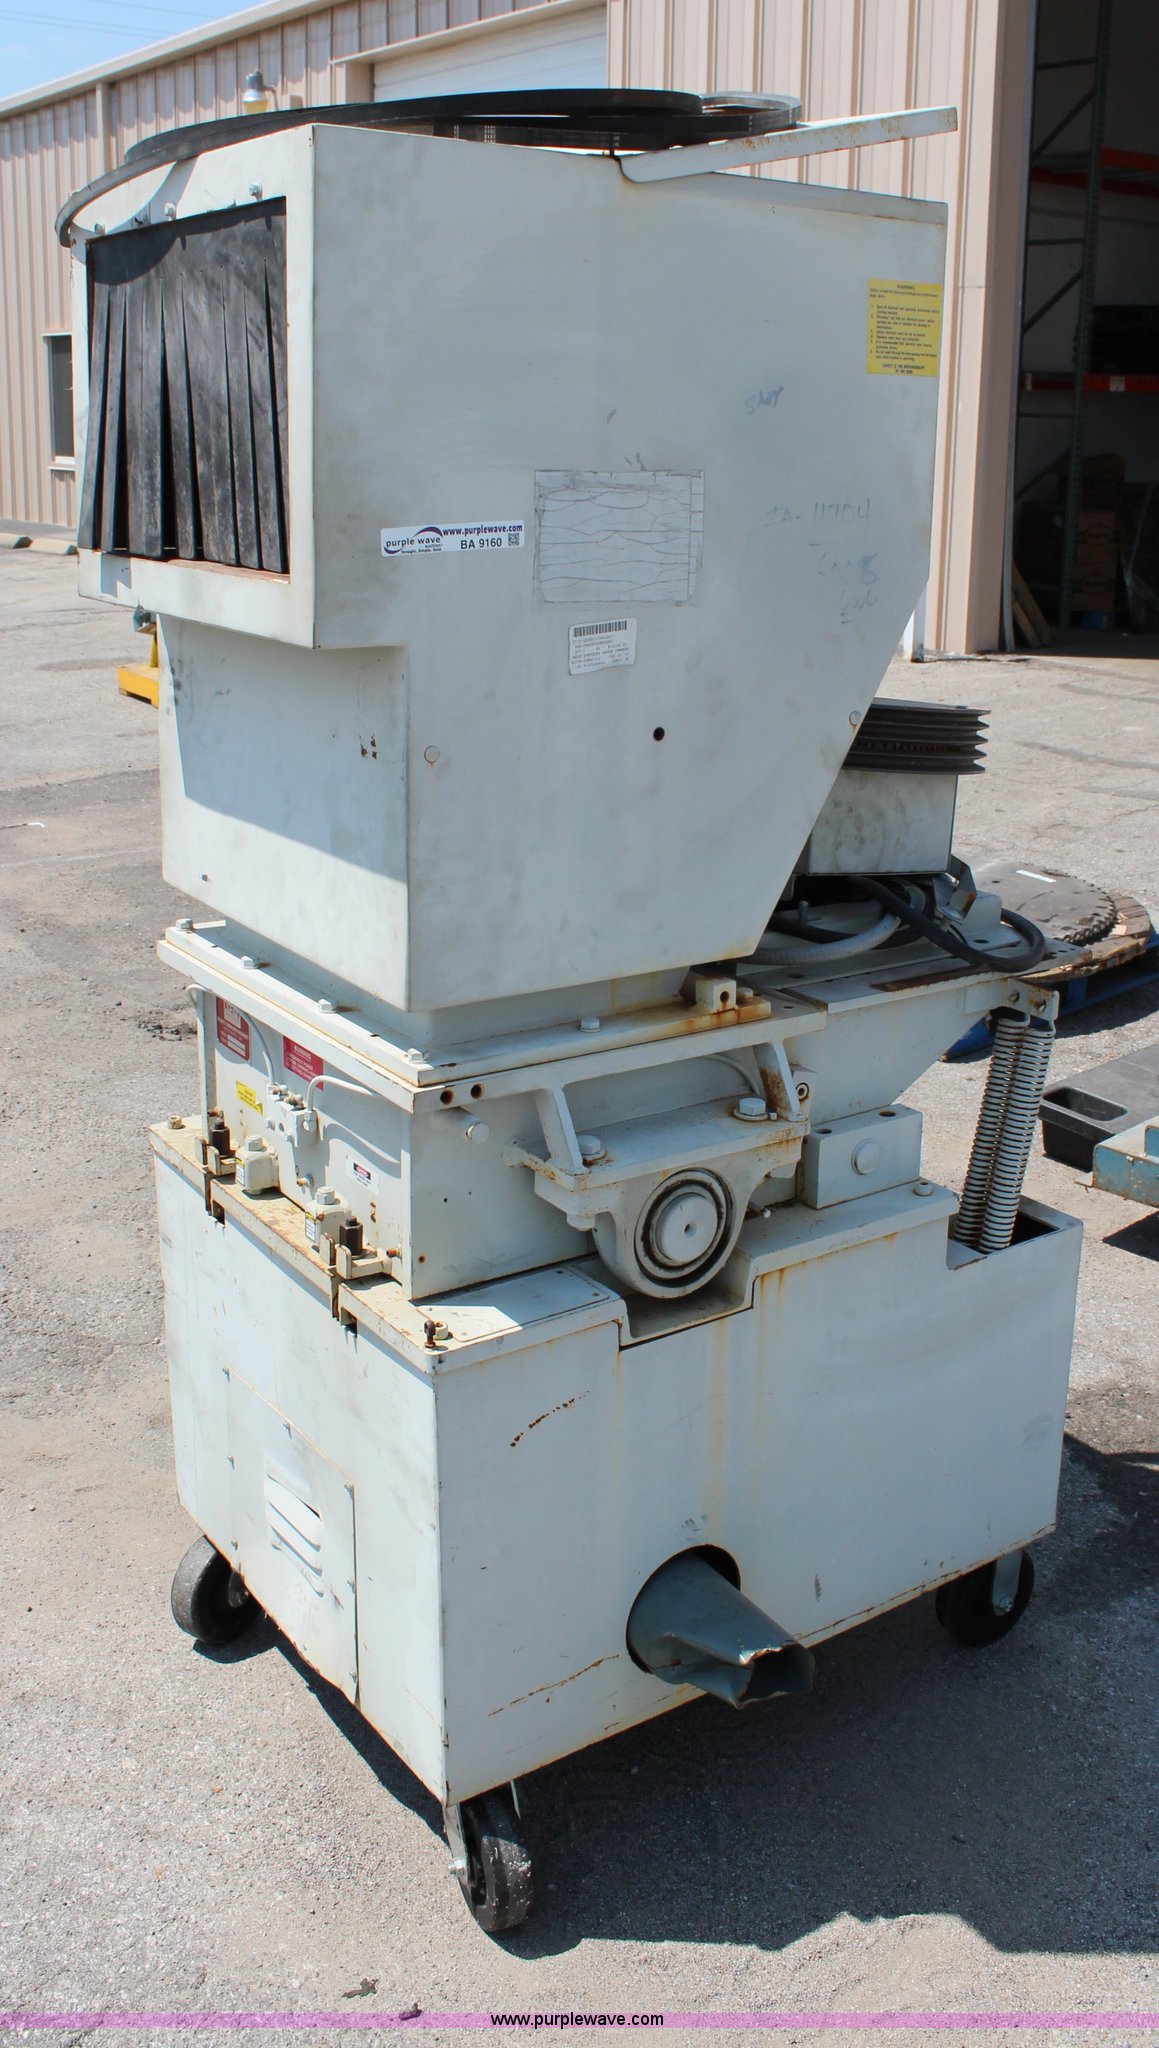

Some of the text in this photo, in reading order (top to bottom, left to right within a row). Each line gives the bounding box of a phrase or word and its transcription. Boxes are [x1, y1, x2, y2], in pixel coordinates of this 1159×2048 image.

[442, 524, 523, 537] www.purplewave.com
[386, 536, 441, 548] purple wave
[460, 538, 502, 550] BA 9160
